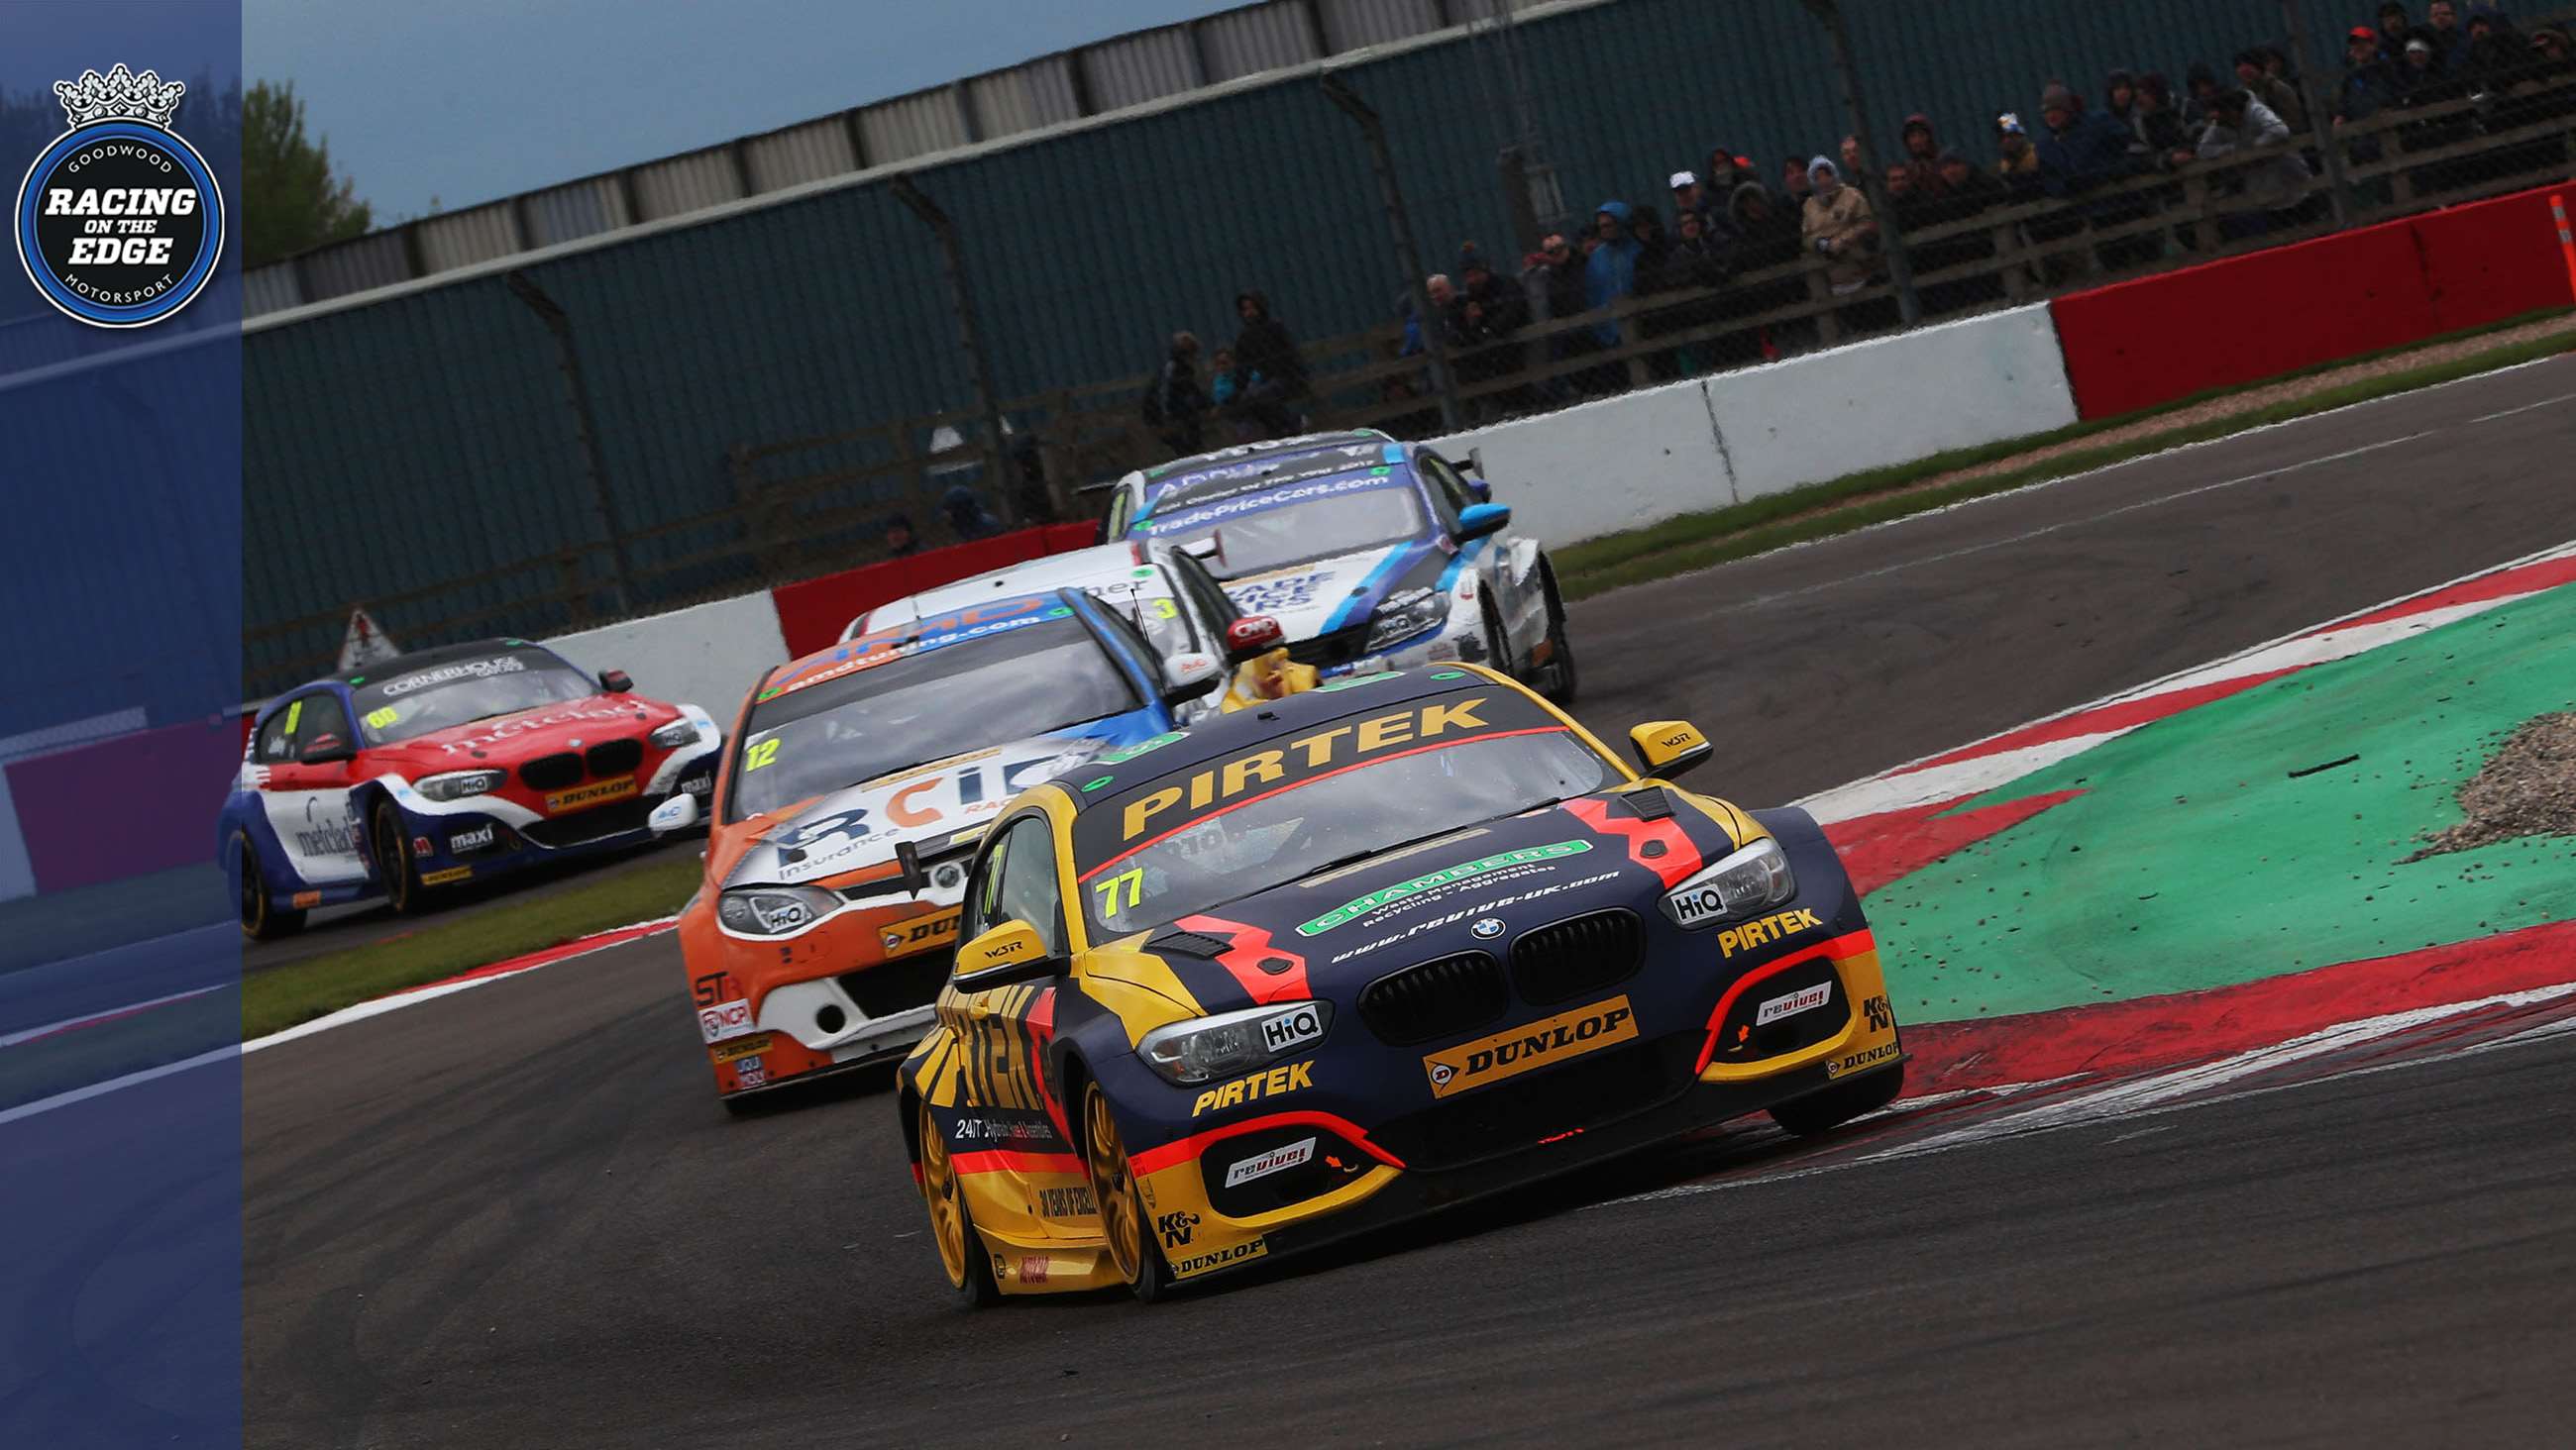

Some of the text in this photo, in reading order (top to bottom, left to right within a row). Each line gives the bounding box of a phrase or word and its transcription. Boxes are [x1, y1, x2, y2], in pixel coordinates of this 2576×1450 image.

[1148, 474, 1389, 536] TradePriceCars.com
[1152, 597, 1178, 619] 3
[787, 616, 1041, 692] amdtuning.com
[745, 738, 782, 773] 12
[1661, 732, 1692, 748] WSR
[1123, 698, 1489, 841] PIRTEK
[450, 822, 494, 850] maxi
[777, 827, 902, 881] Insurance
[1096, 867, 1144, 920] 77
[1316, 844, 1573, 930] CHAMBERS
[1363, 894, 1443, 928] Recycling
[1458, 865, 1556, 892] Aggregates
[1371, 863, 1537, 916] Waste Management
[1674, 889, 1724, 921] HiQ
[771, 905, 803, 929] HiQ
[1717, 907, 1824, 959] PIRTEK
[984, 940, 1023, 959] WSR
[1264, 1011, 1319, 1047] HiQ
[1464, 1006, 1632, 1076] DUNLOP
[1192, 1060, 1316, 1118] PIRTEK
[1181, 1238, 1264, 1274] DUNLOP
